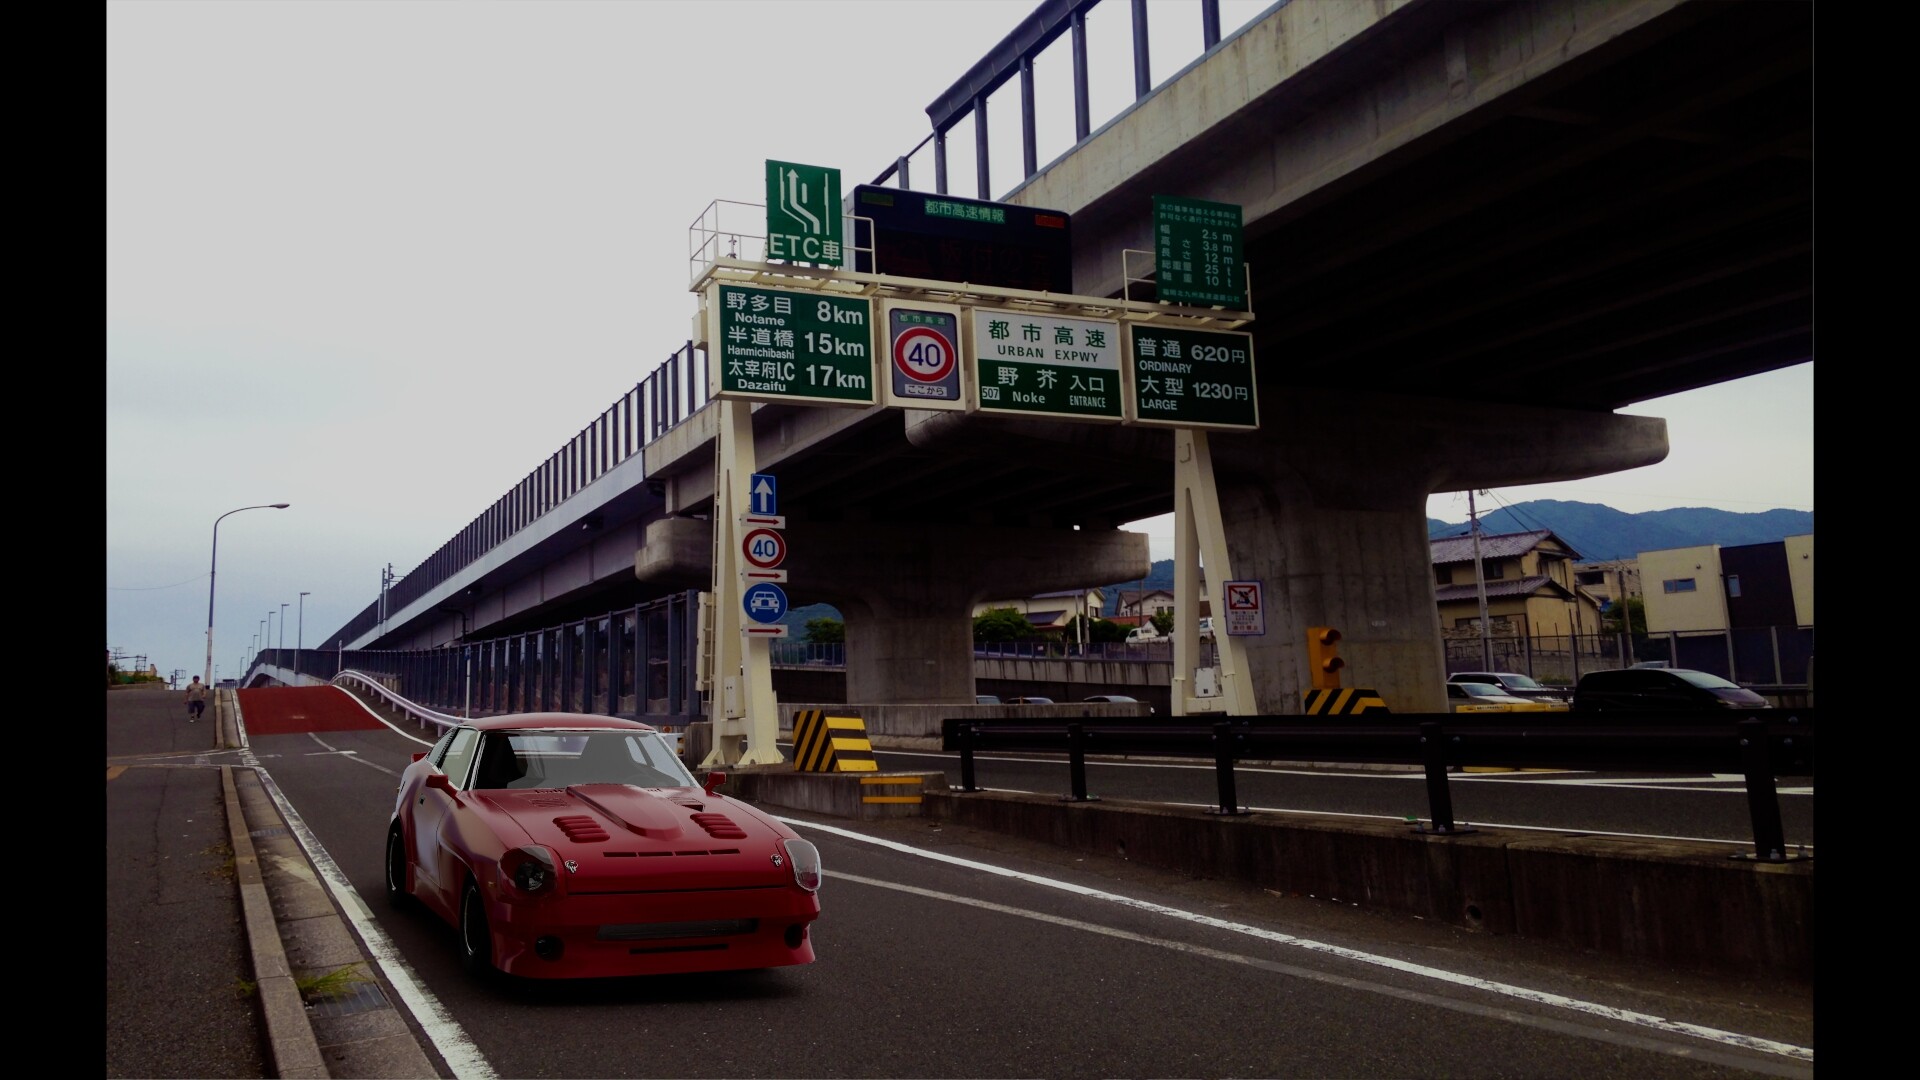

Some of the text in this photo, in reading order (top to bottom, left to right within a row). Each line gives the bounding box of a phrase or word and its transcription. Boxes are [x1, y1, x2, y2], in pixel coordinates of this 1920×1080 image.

[925, 199, 1006, 224] 都市高速情報
[1160, 224, 1232, 242] 幅 2.5 m
[769, 233, 841, 261] ETC車
[1202, 241, 1218, 252] 3.8
[1223, 244, 1233, 253] m
[1204, 253, 1218, 264] 12
[1223, 256, 1233, 265] m
[1162, 260, 1231, 277] 総重量 25 t
[1205, 276, 1220, 286] 10
[1227, 278, 1232, 288] t
[726, 292, 863, 325] 野多目 8km
[735, 312, 785, 327] Notame
[900, 314, 946, 325] 都市高速
[728, 326, 864, 357] 半道橋 15km
[988, 320, 1106, 349] 都市高速
[727, 344, 795, 360] Hanmichibashi
[908, 342, 940, 367] 40
[998, 345, 1098, 363] URBAN EXPWY
[1138, 337, 1246, 364] 普通 620円
[1139, 361, 1192, 374] ORDINARY
[737, 378, 787, 392] Dazaifu
[806, 365, 866, 389] 17km
[998, 366, 1104, 393] 野芥 入口
[908, 385, 944, 396] ここから
[982, 388, 1106, 408] 507 Noke ENTRANCE
[1140, 377, 1248, 401] 大型 1230円
[1142, 398, 1178, 410] LARGE
[752, 540, 776, 557] 40
